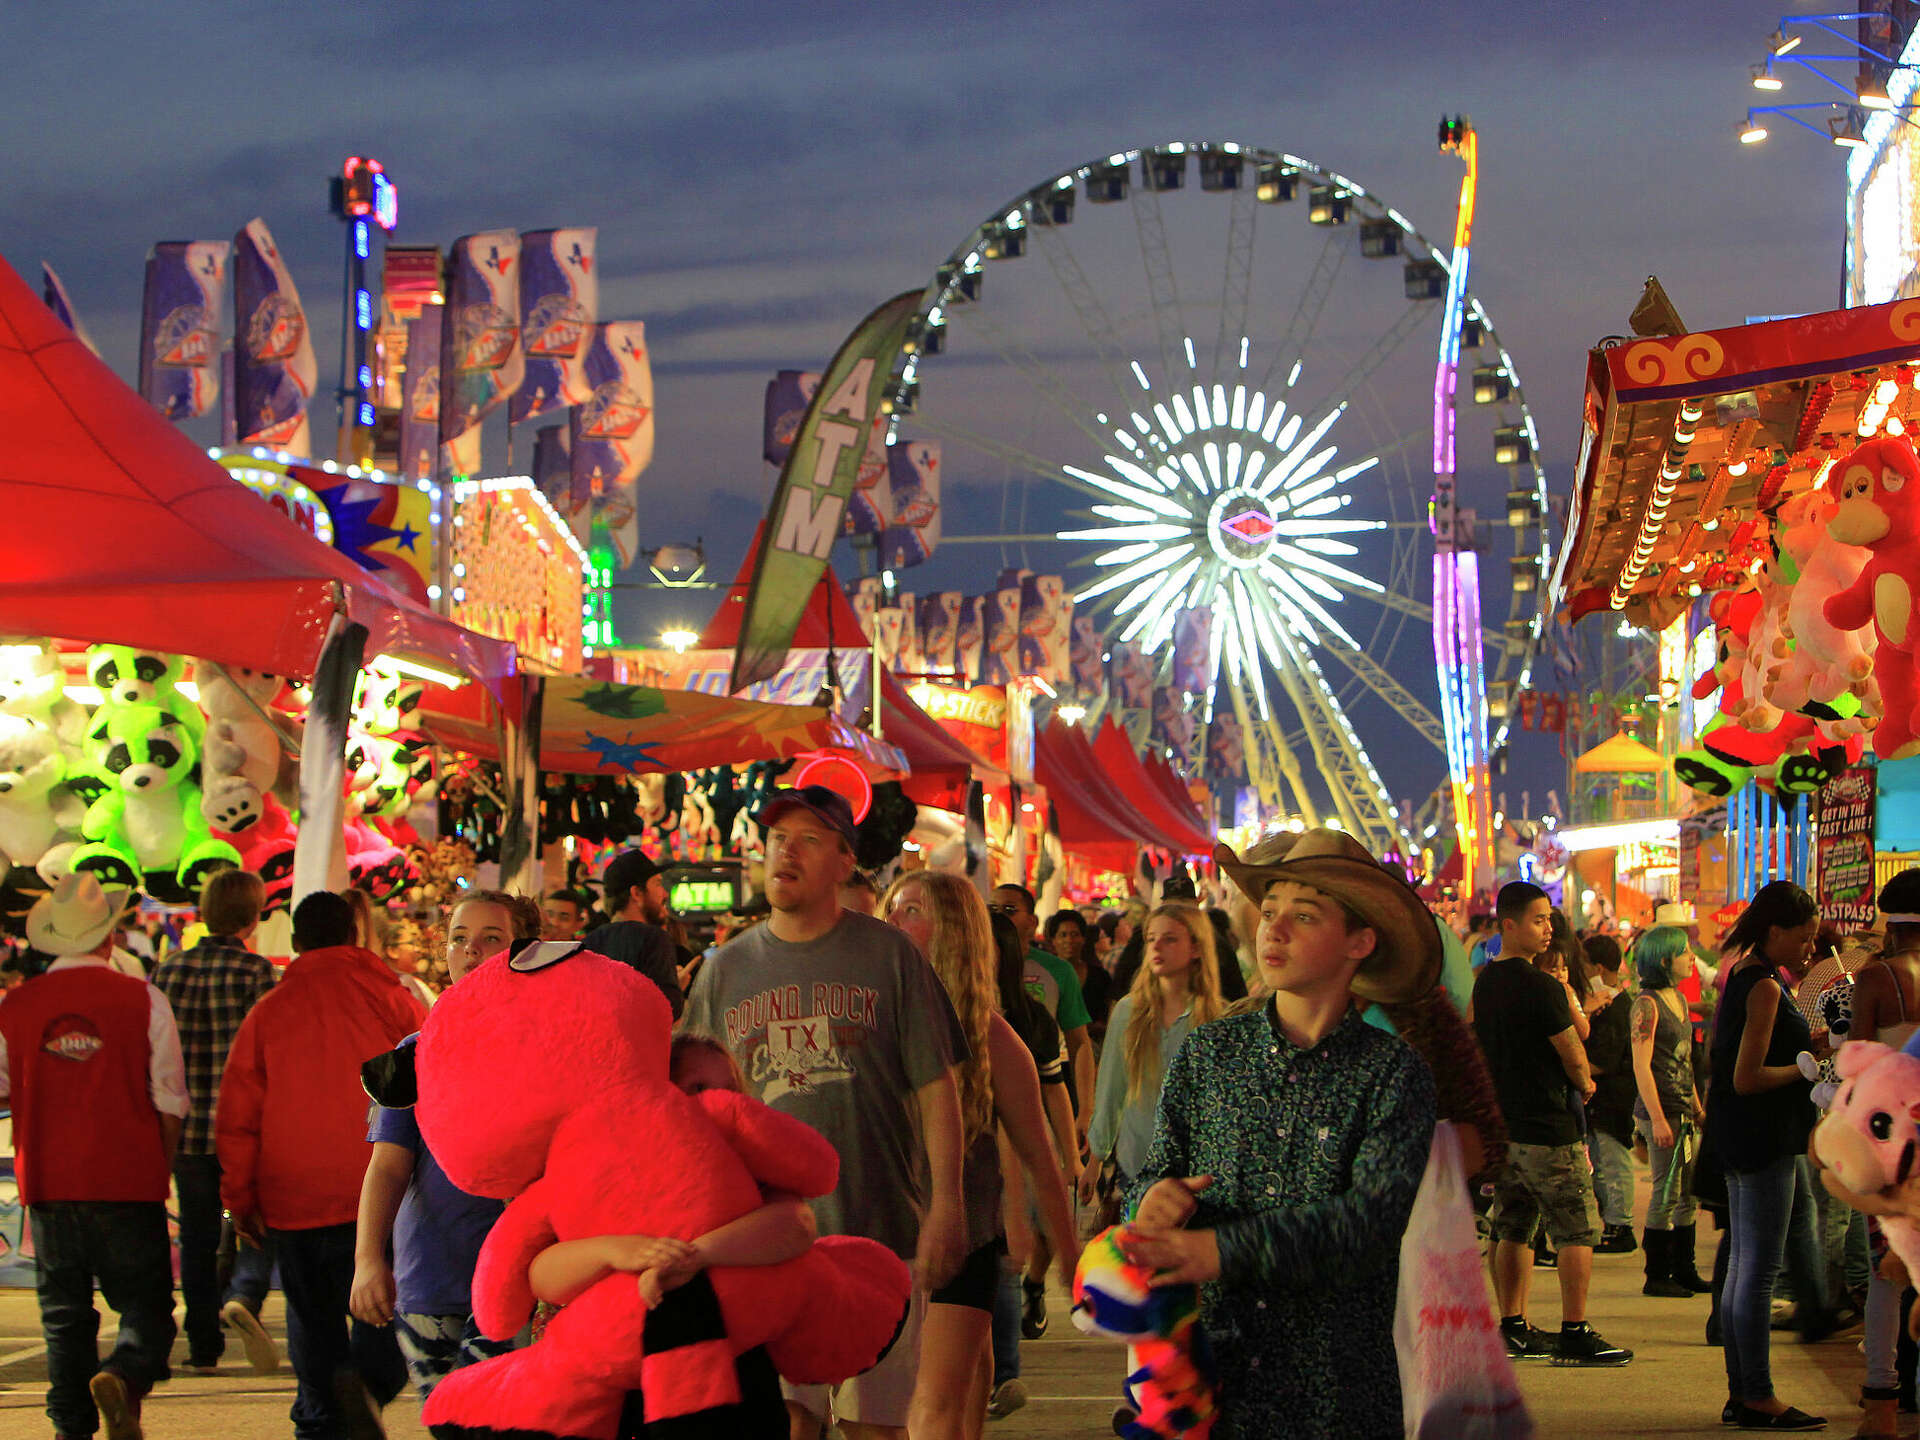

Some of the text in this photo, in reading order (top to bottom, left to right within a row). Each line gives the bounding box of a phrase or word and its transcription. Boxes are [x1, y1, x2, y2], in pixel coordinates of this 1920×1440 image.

[775, 357, 877, 560] ATM
[946, 692, 1002, 727] STICK
[1821, 802, 1867, 822] GET IN THE
[1819, 821, 1841, 837] FAST
[1842, 816, 1867, 833] LANE
[1822, 841, 1866, 869] FAST
[673, 882, 733, 905] ATM
[1817, 902, 1875, 921] FASTPASS
[724, 982, 879, 1047] ROUND ROCK
[780, 1022, 819, 1051] TX
